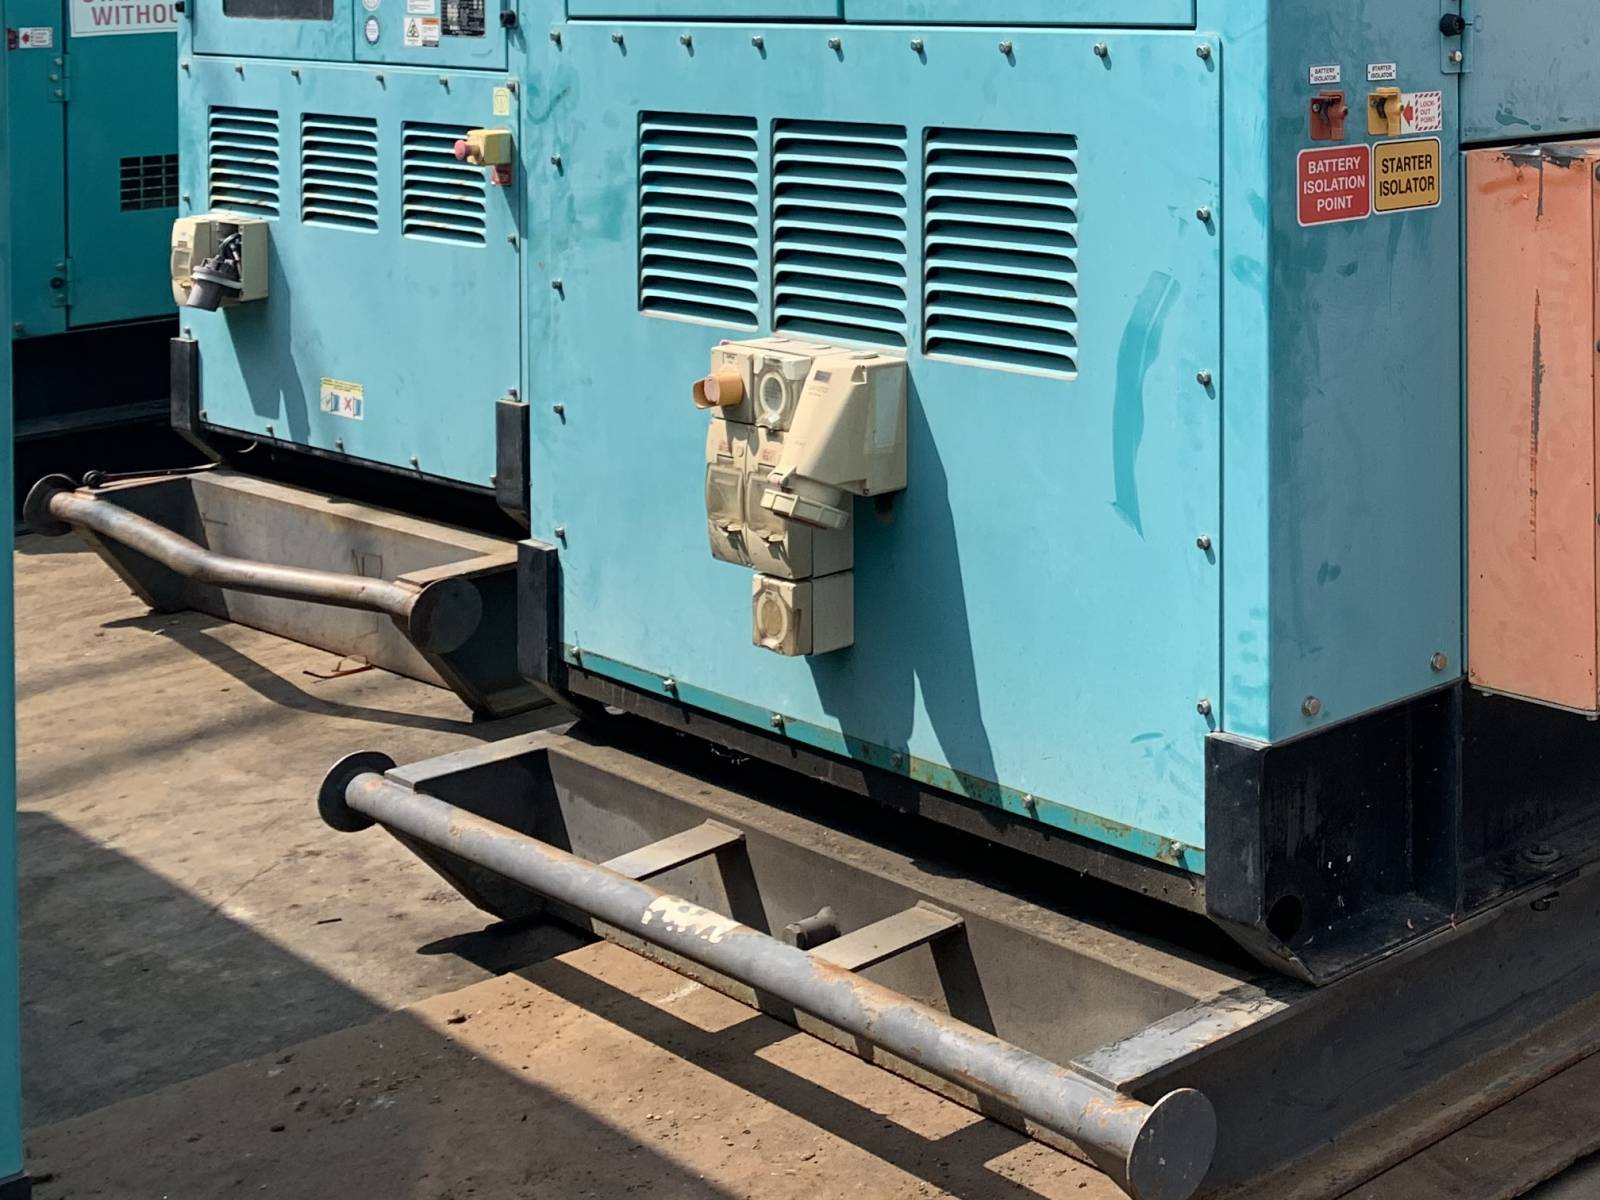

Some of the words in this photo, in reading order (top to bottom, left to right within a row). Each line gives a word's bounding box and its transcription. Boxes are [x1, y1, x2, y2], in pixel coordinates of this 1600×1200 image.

[1308, 156, 1361, 175] BATTERY
[1381, 154, 1432, 174] STARTER
[1303, 175, 1366, 195] ISOLATION
[1379, 175, 1435, 197] ISOLATOR
[1317, 195, 1353, 212] POINT
